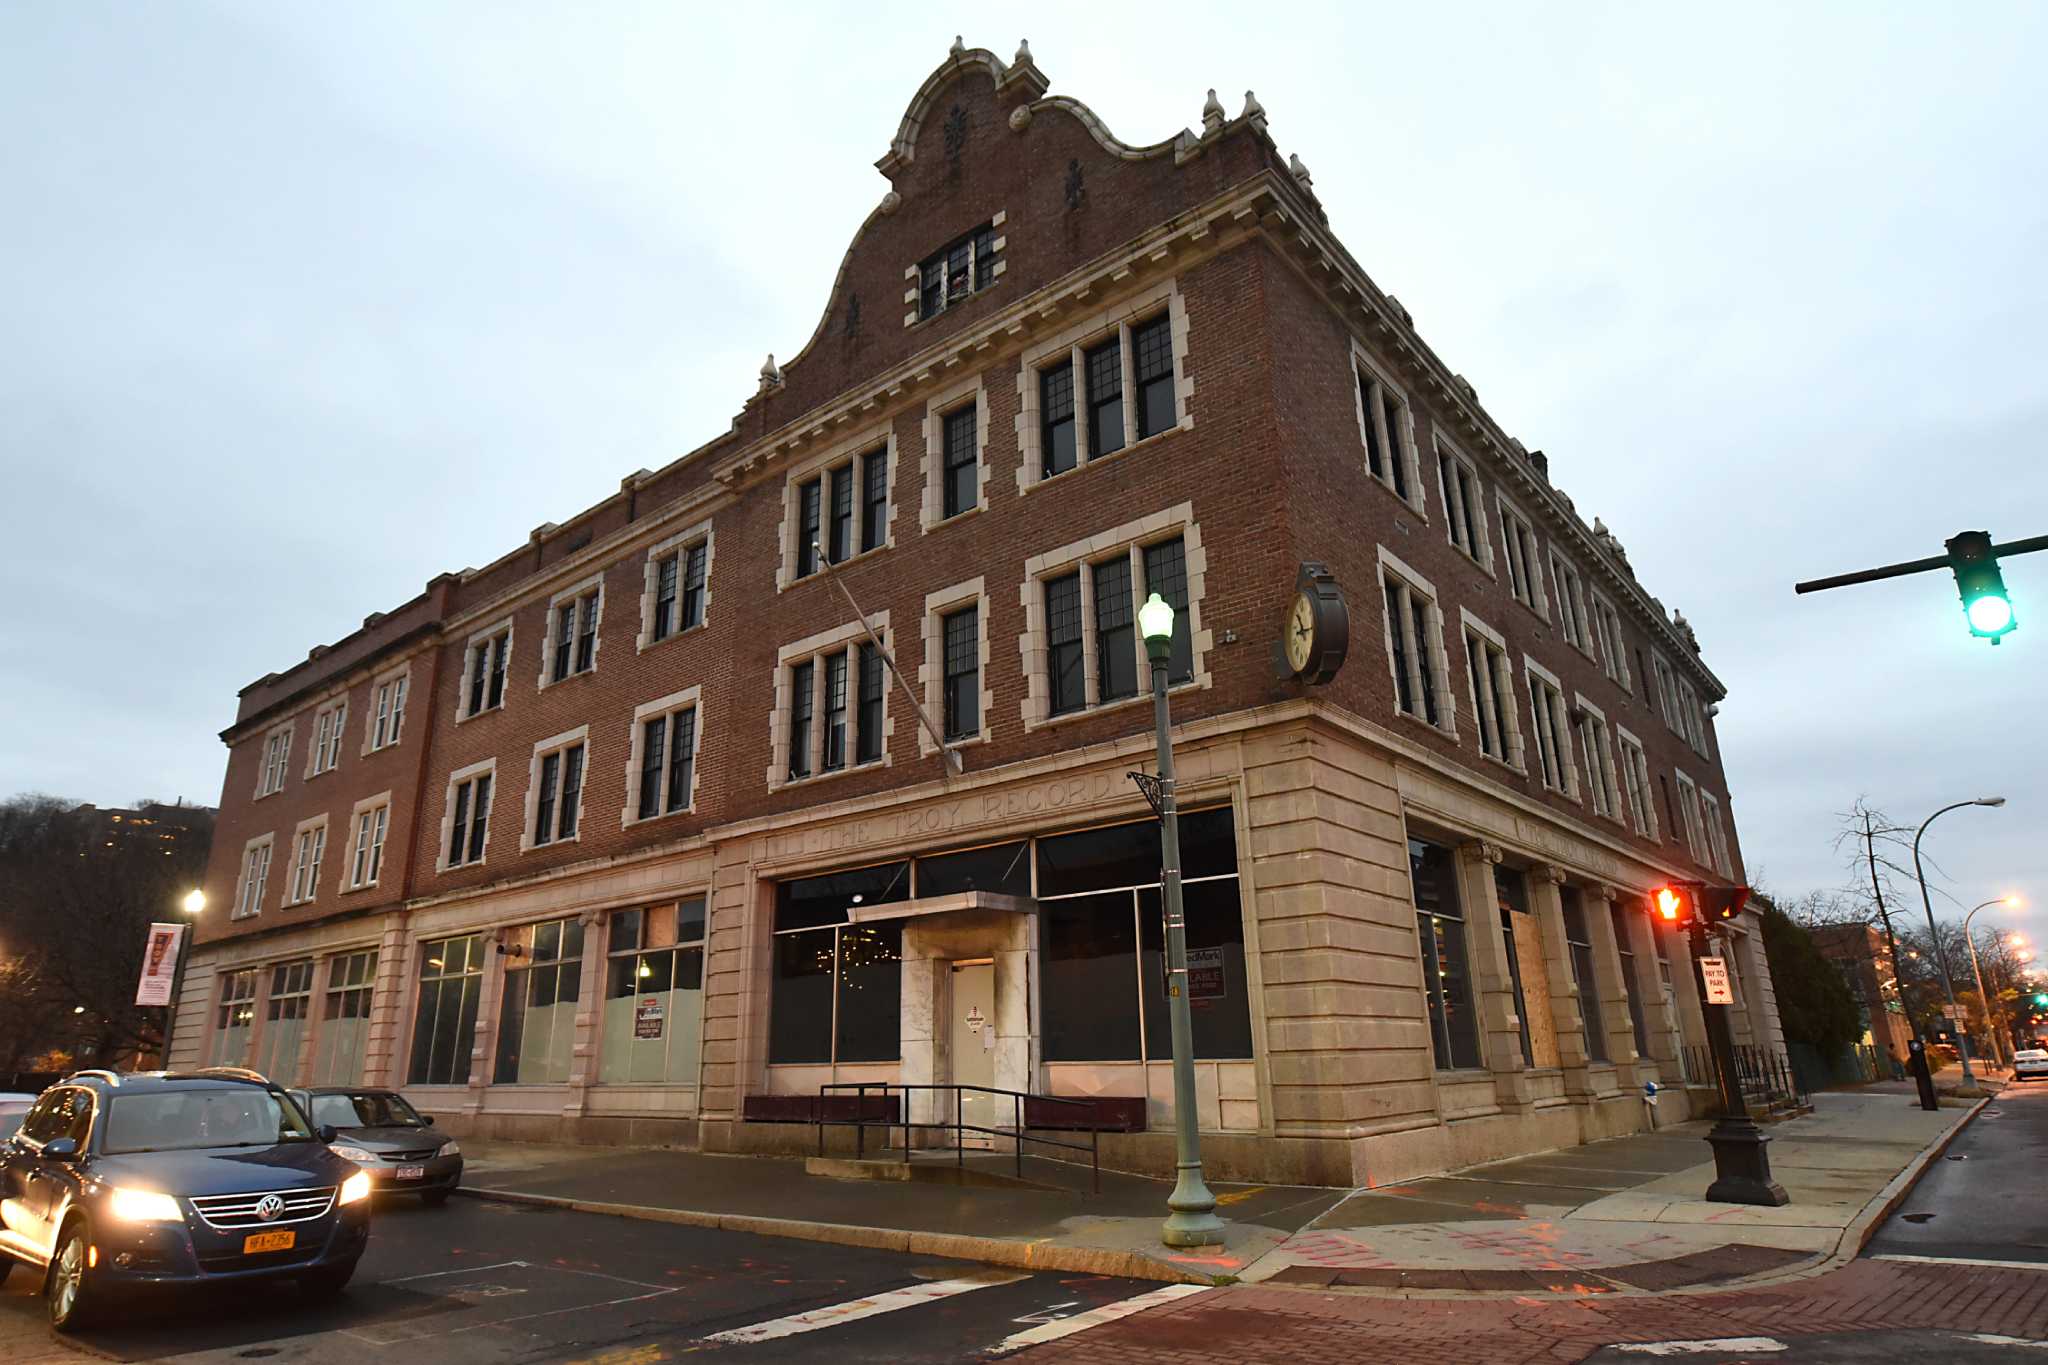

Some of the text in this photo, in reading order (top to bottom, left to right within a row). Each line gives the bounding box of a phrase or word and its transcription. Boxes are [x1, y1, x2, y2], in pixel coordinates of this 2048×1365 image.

[823, 776, 1112, 850] THE TROY RECORD
[1716, 969, 1725, 978] TO
